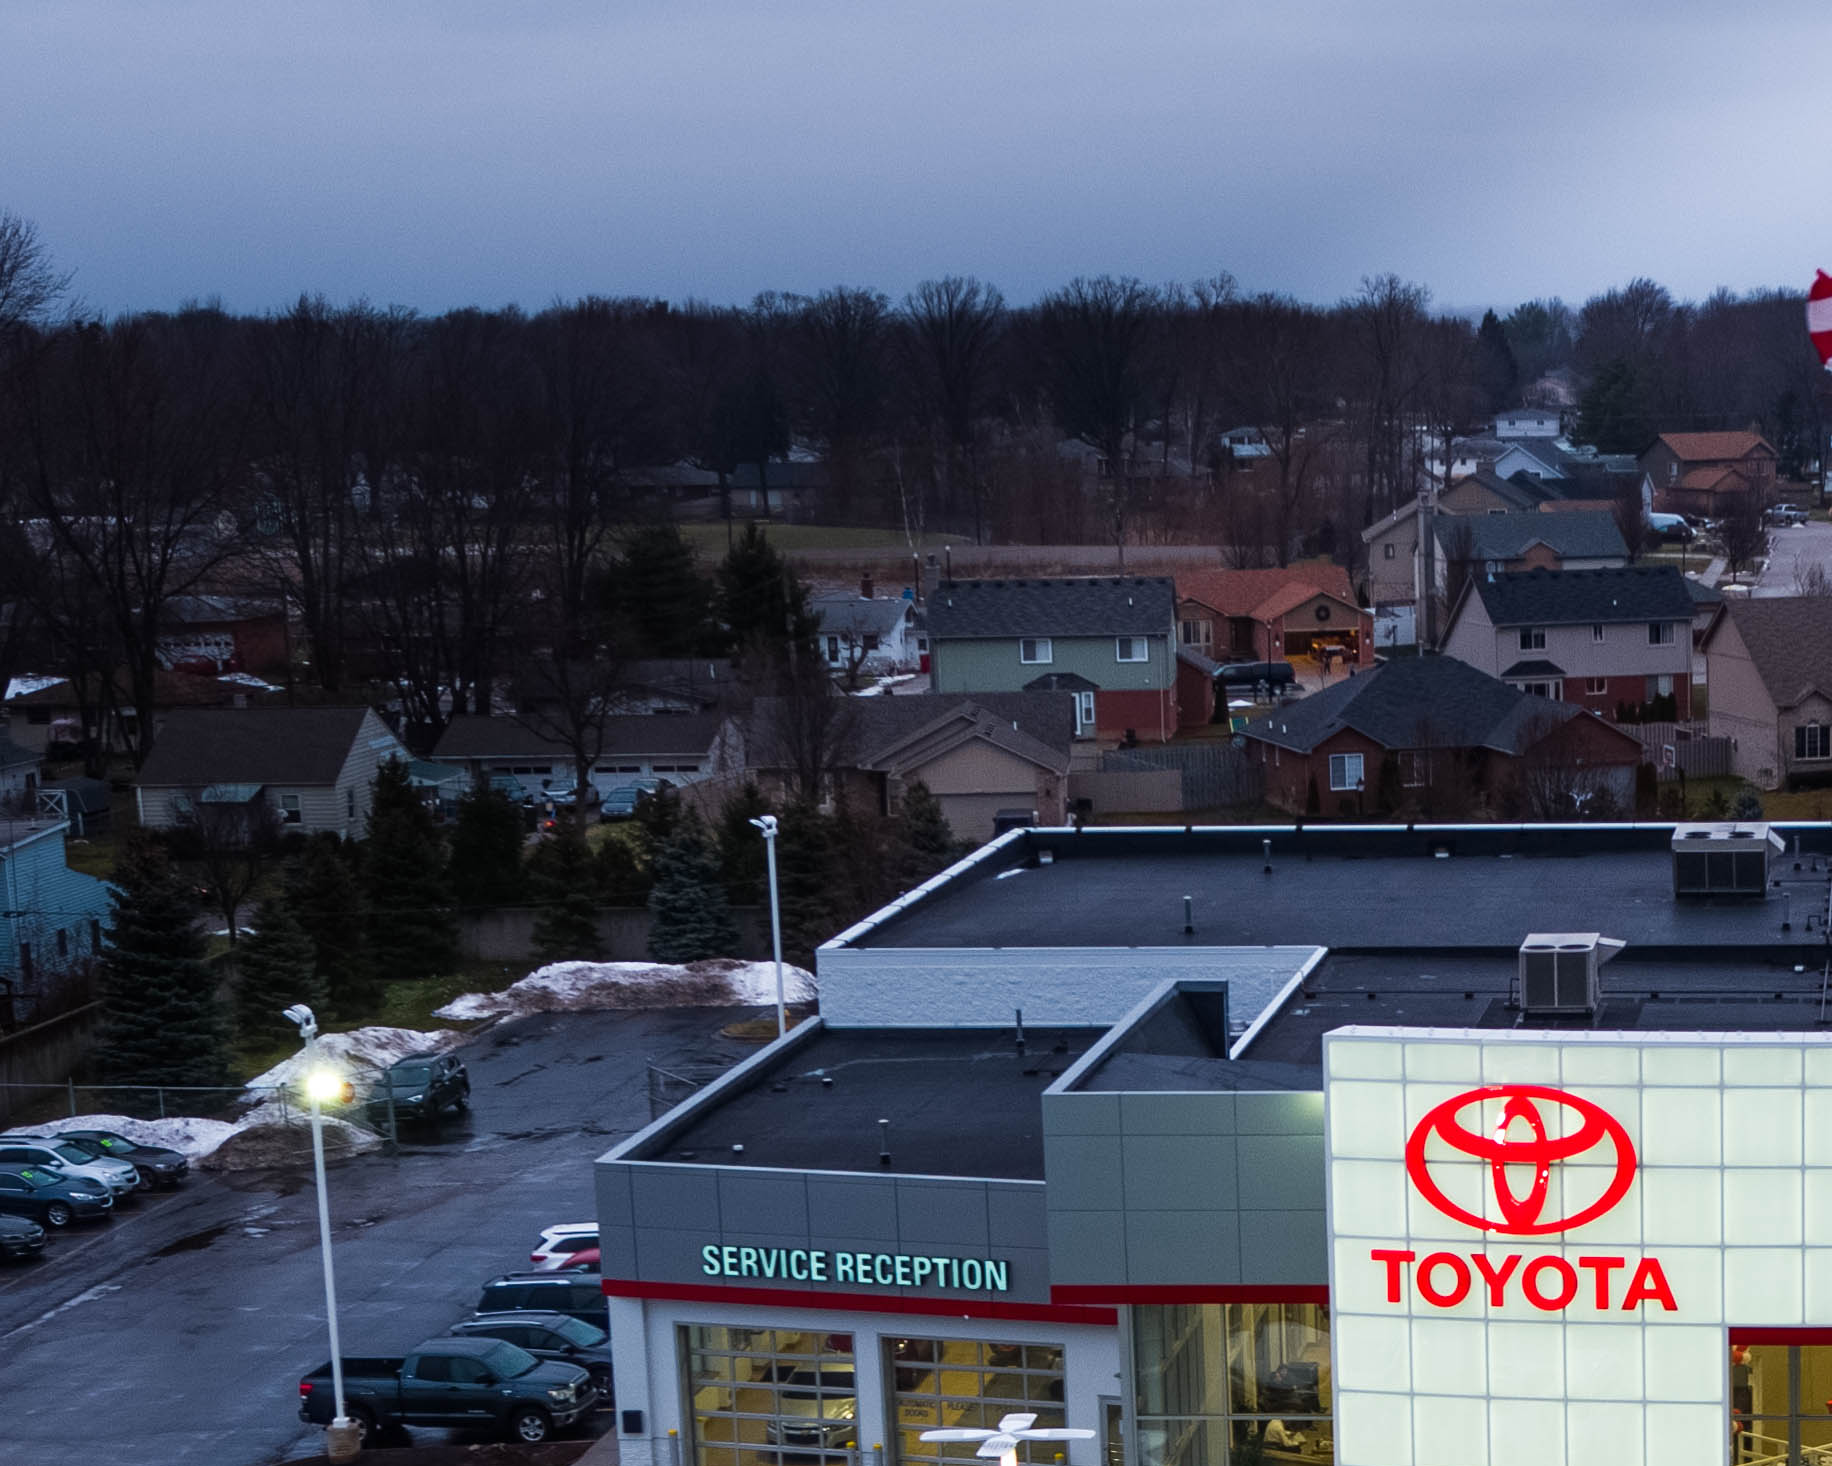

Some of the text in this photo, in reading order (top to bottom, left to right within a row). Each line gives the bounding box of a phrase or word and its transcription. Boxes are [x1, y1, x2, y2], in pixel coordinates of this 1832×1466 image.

[702, 1245, 1008, 1291] SERVICE RECEPTION
[1371, 1249, 1678, 1311] TOYOTA
